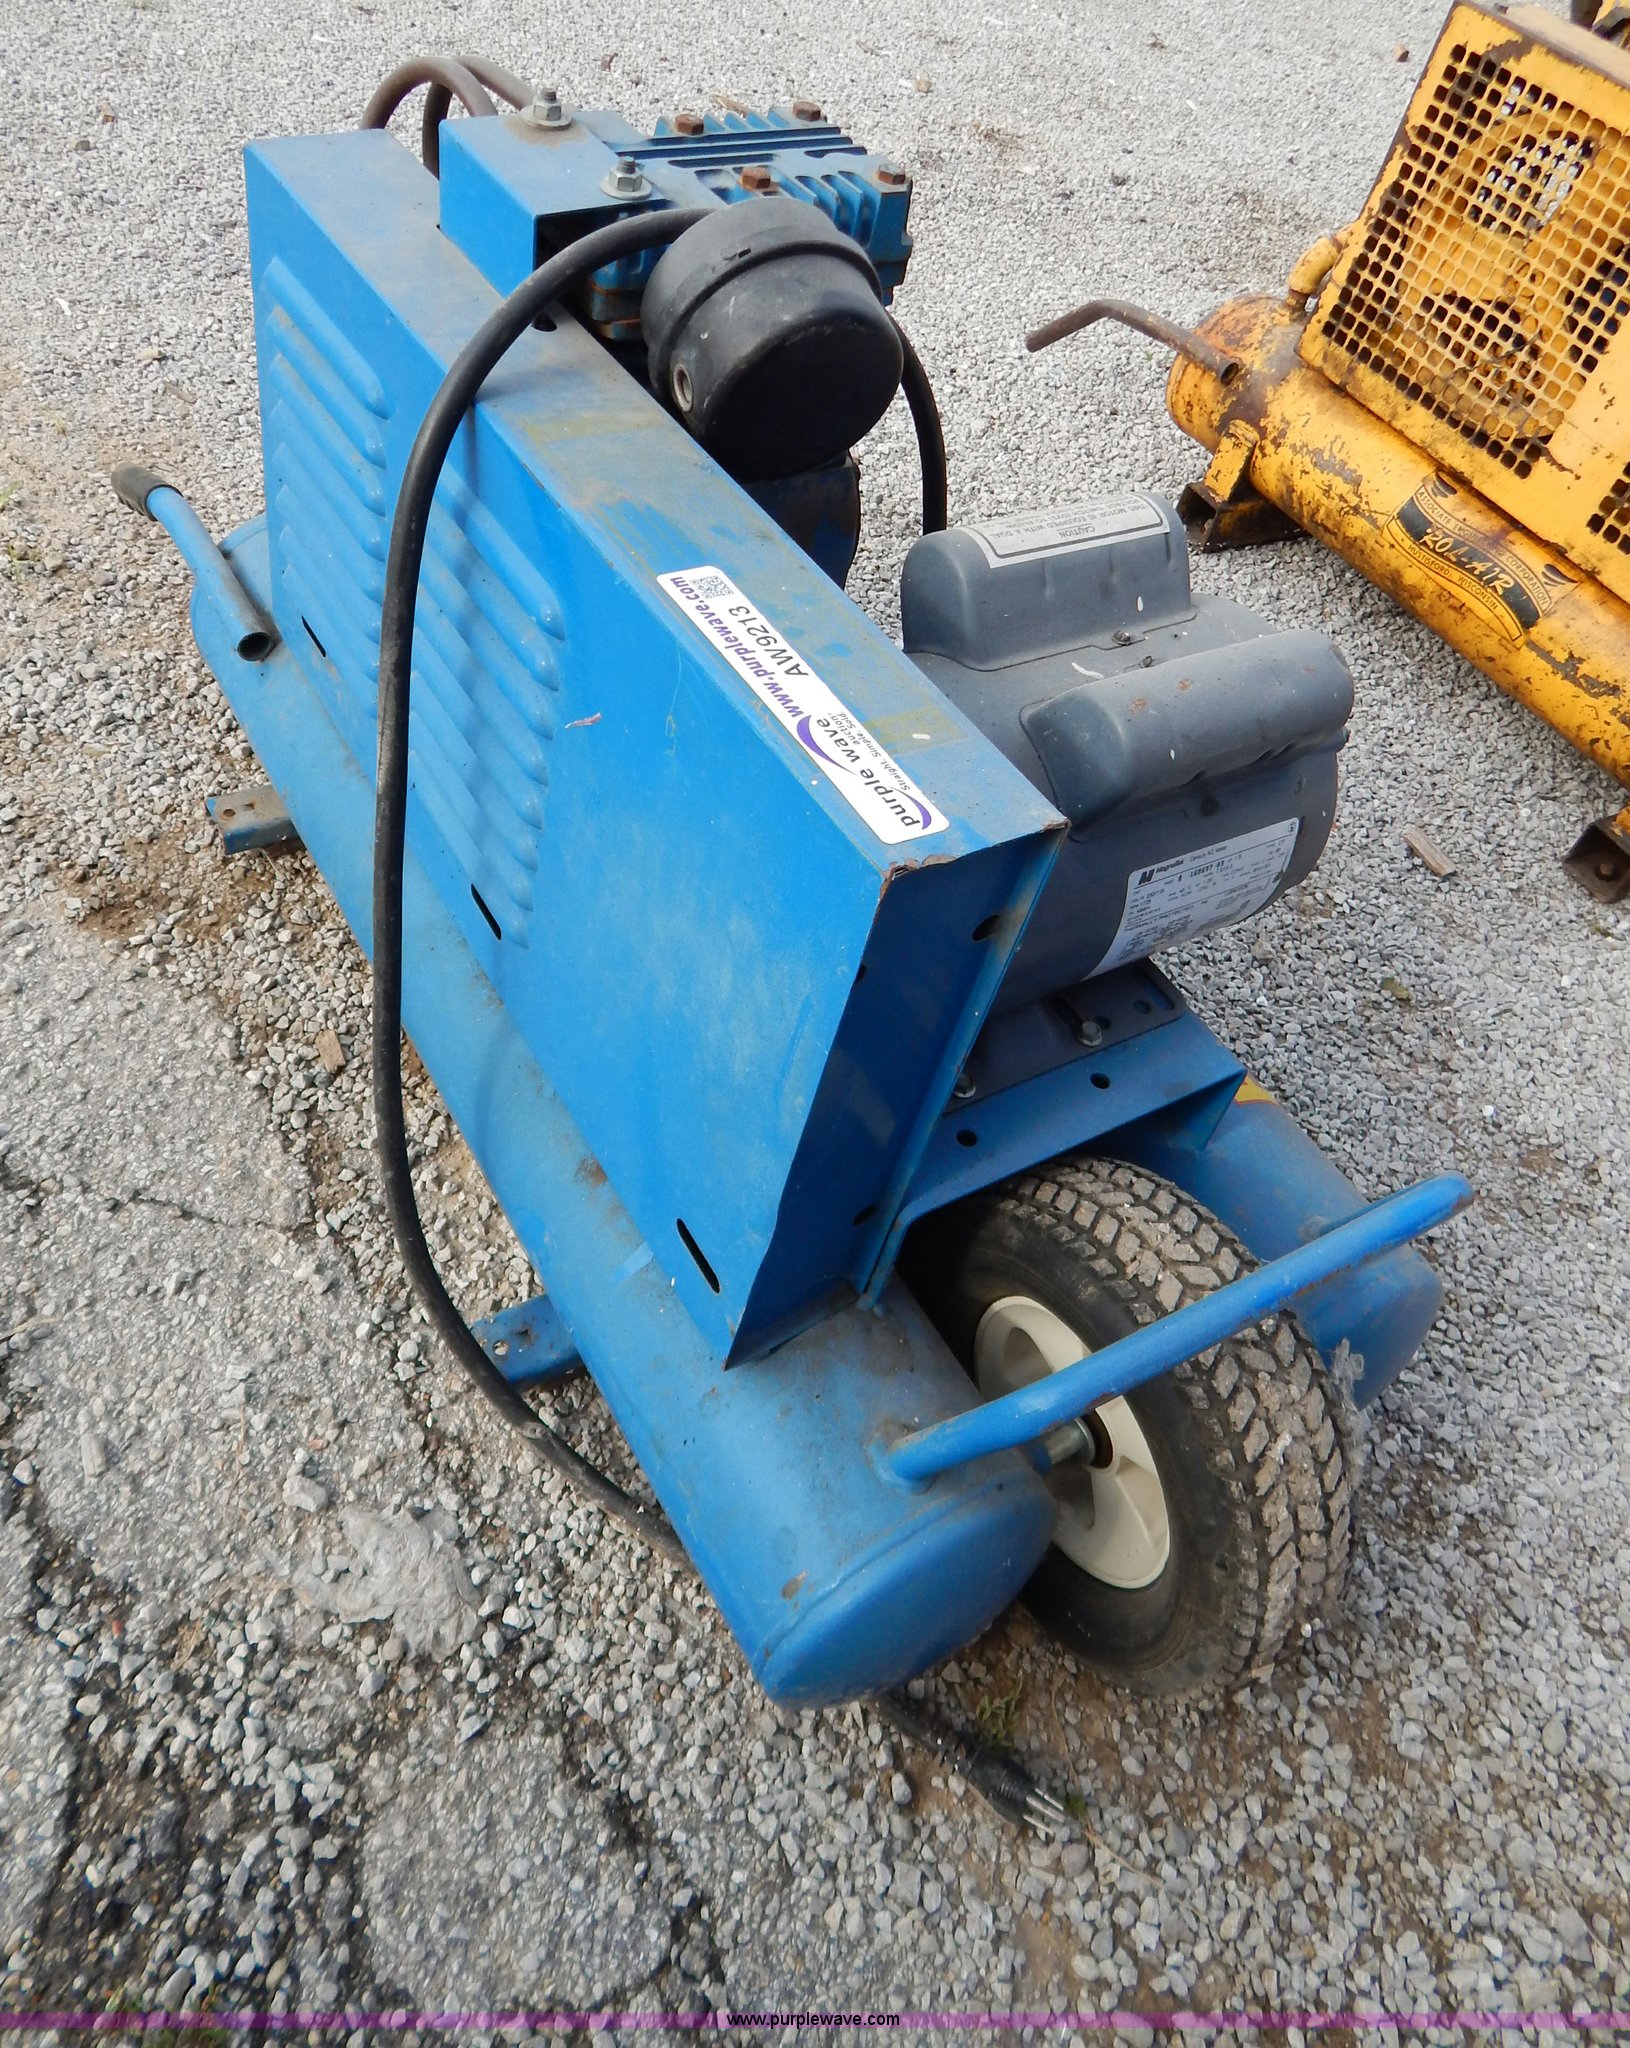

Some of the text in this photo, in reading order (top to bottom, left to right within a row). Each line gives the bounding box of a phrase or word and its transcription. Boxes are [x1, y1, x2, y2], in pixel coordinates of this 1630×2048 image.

[1058, 526, 1096, 538] CAUTION
[1418, 490, 1452, 525] ASSOCIATE
[1505, 555, 1549, 606] CORPORATION
[1458, 575, 1499, 610] WISCONSIN
[669, 576, 804, 718] www.purplewave.com
[728, 605, 808, 678] AW9213
[830, 715, 860, 745] auction
[837, 711, 911, 791] Straight. Simple. Sold.
[816, 718, 920, 828] purple wave
